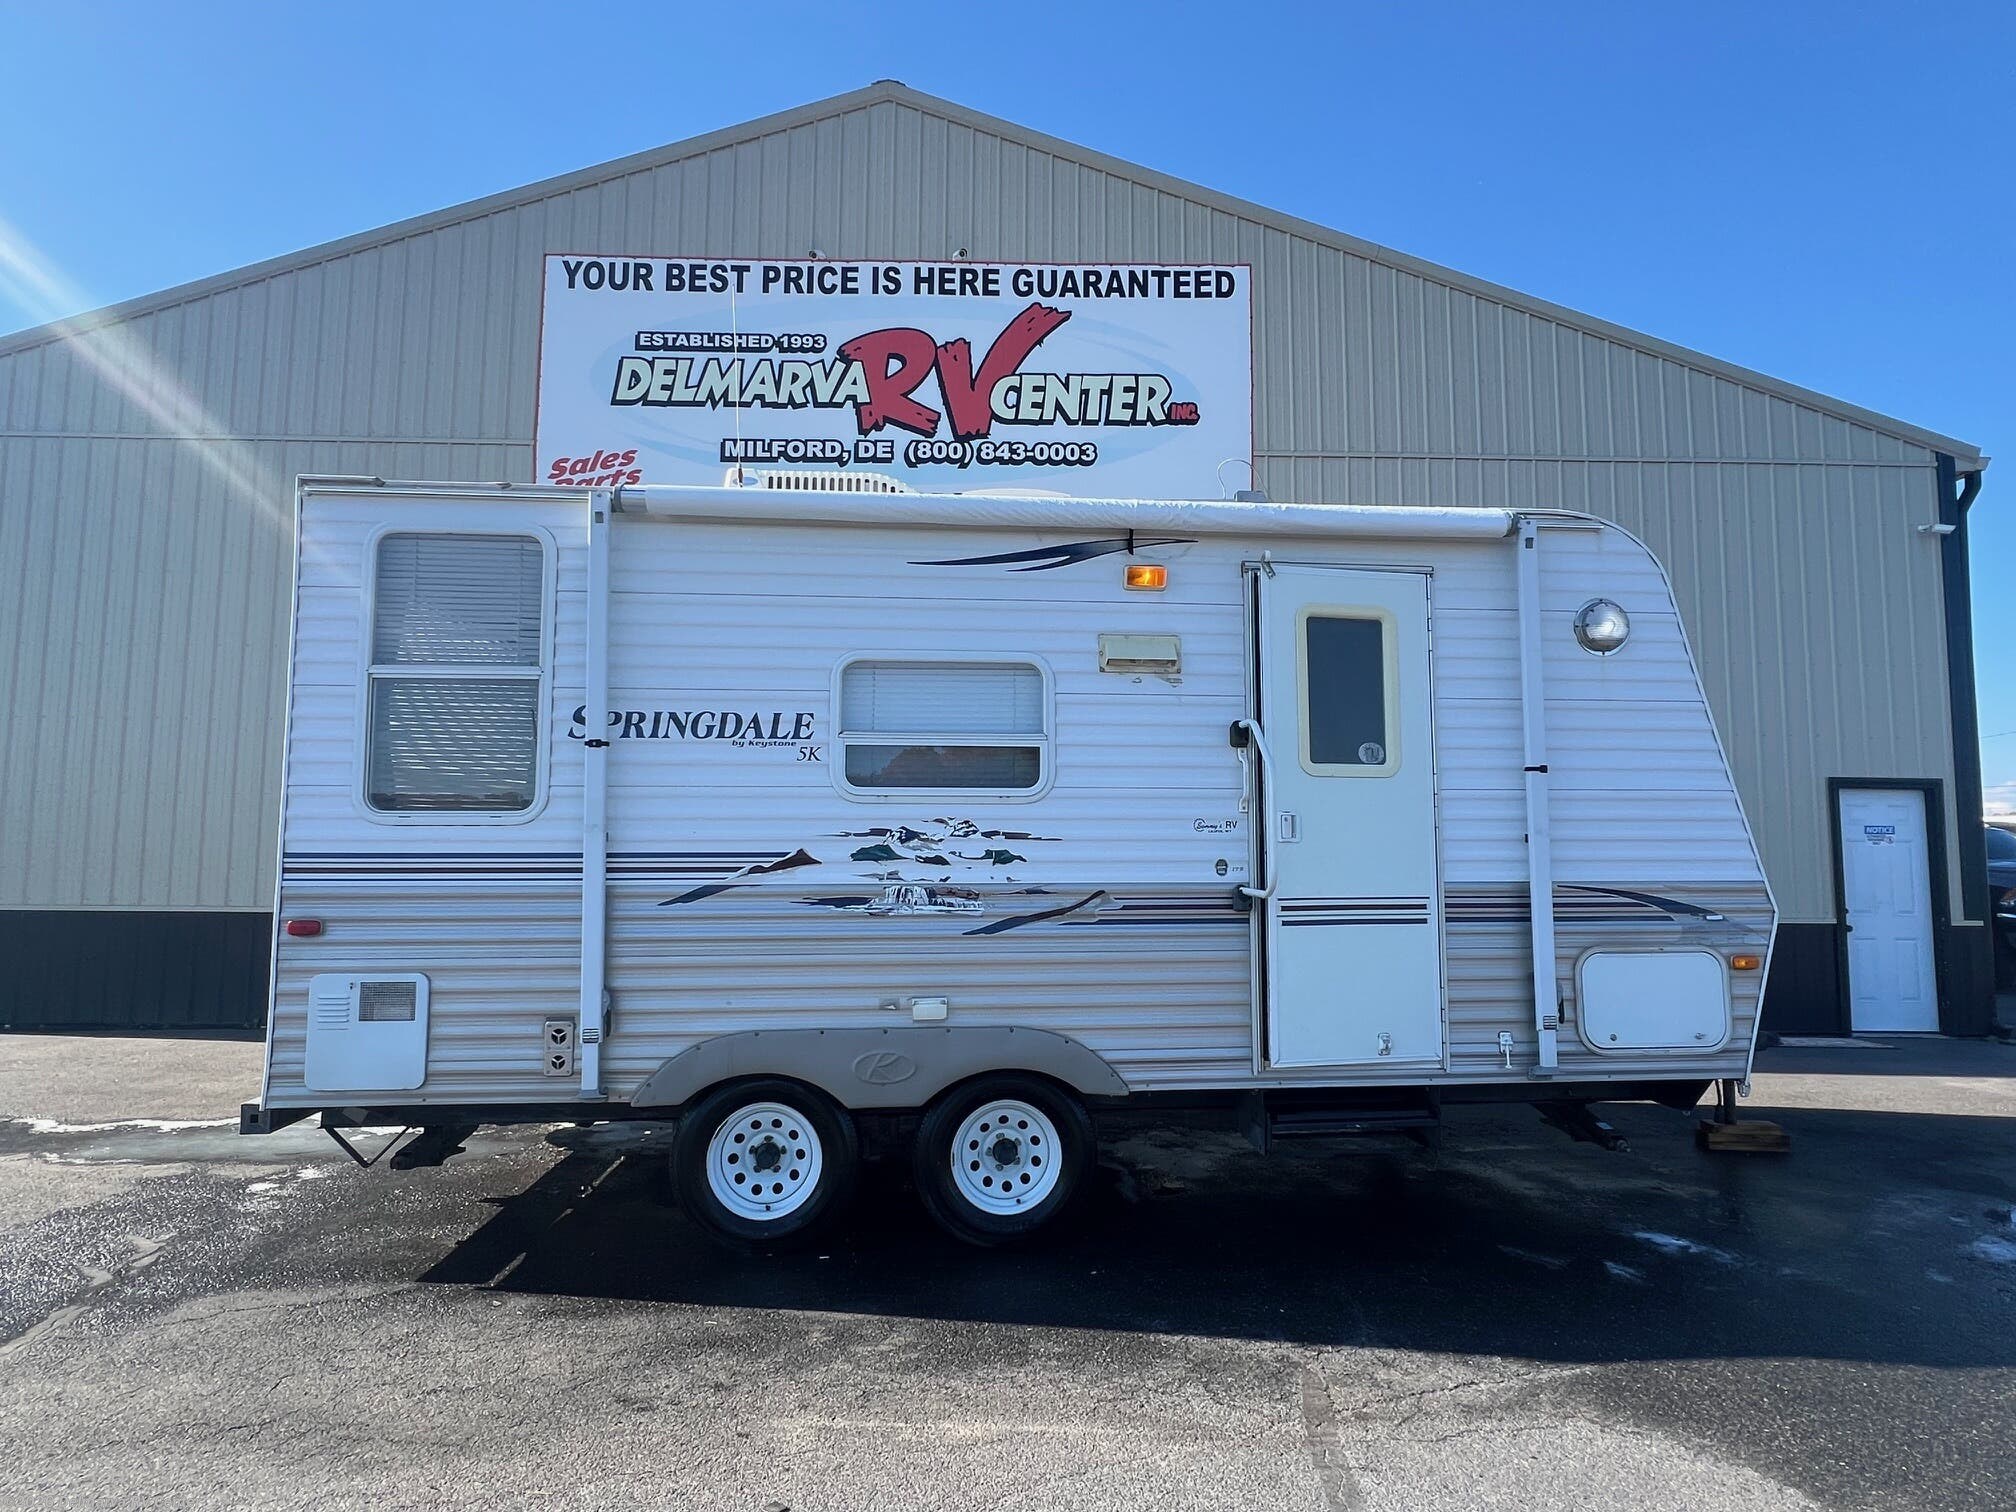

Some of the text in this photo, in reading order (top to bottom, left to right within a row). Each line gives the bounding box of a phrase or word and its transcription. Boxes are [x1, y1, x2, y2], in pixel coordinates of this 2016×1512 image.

[562, 260, 1236, 299] YOUR BEST PRICE IS HERE GUARANTEED
[637, 332, 826, 352] ESTABLISHED 1993
[612, 357, 872, 409] DELMARVA
[837, 302, 1072, 439] RV
[989, 373, 1173, 427] CENTER
[723, 440, 1096, 466] MILFORD, DE (800) 843-0003
[547, 450, 638, 479] Sales
[732, 739, 797, 748] by Keystone
[796, 746, 821, 761] 5K
[1225, 820, 1238, 829] RV
[1865, 826, 1893, 834] NOTICE
